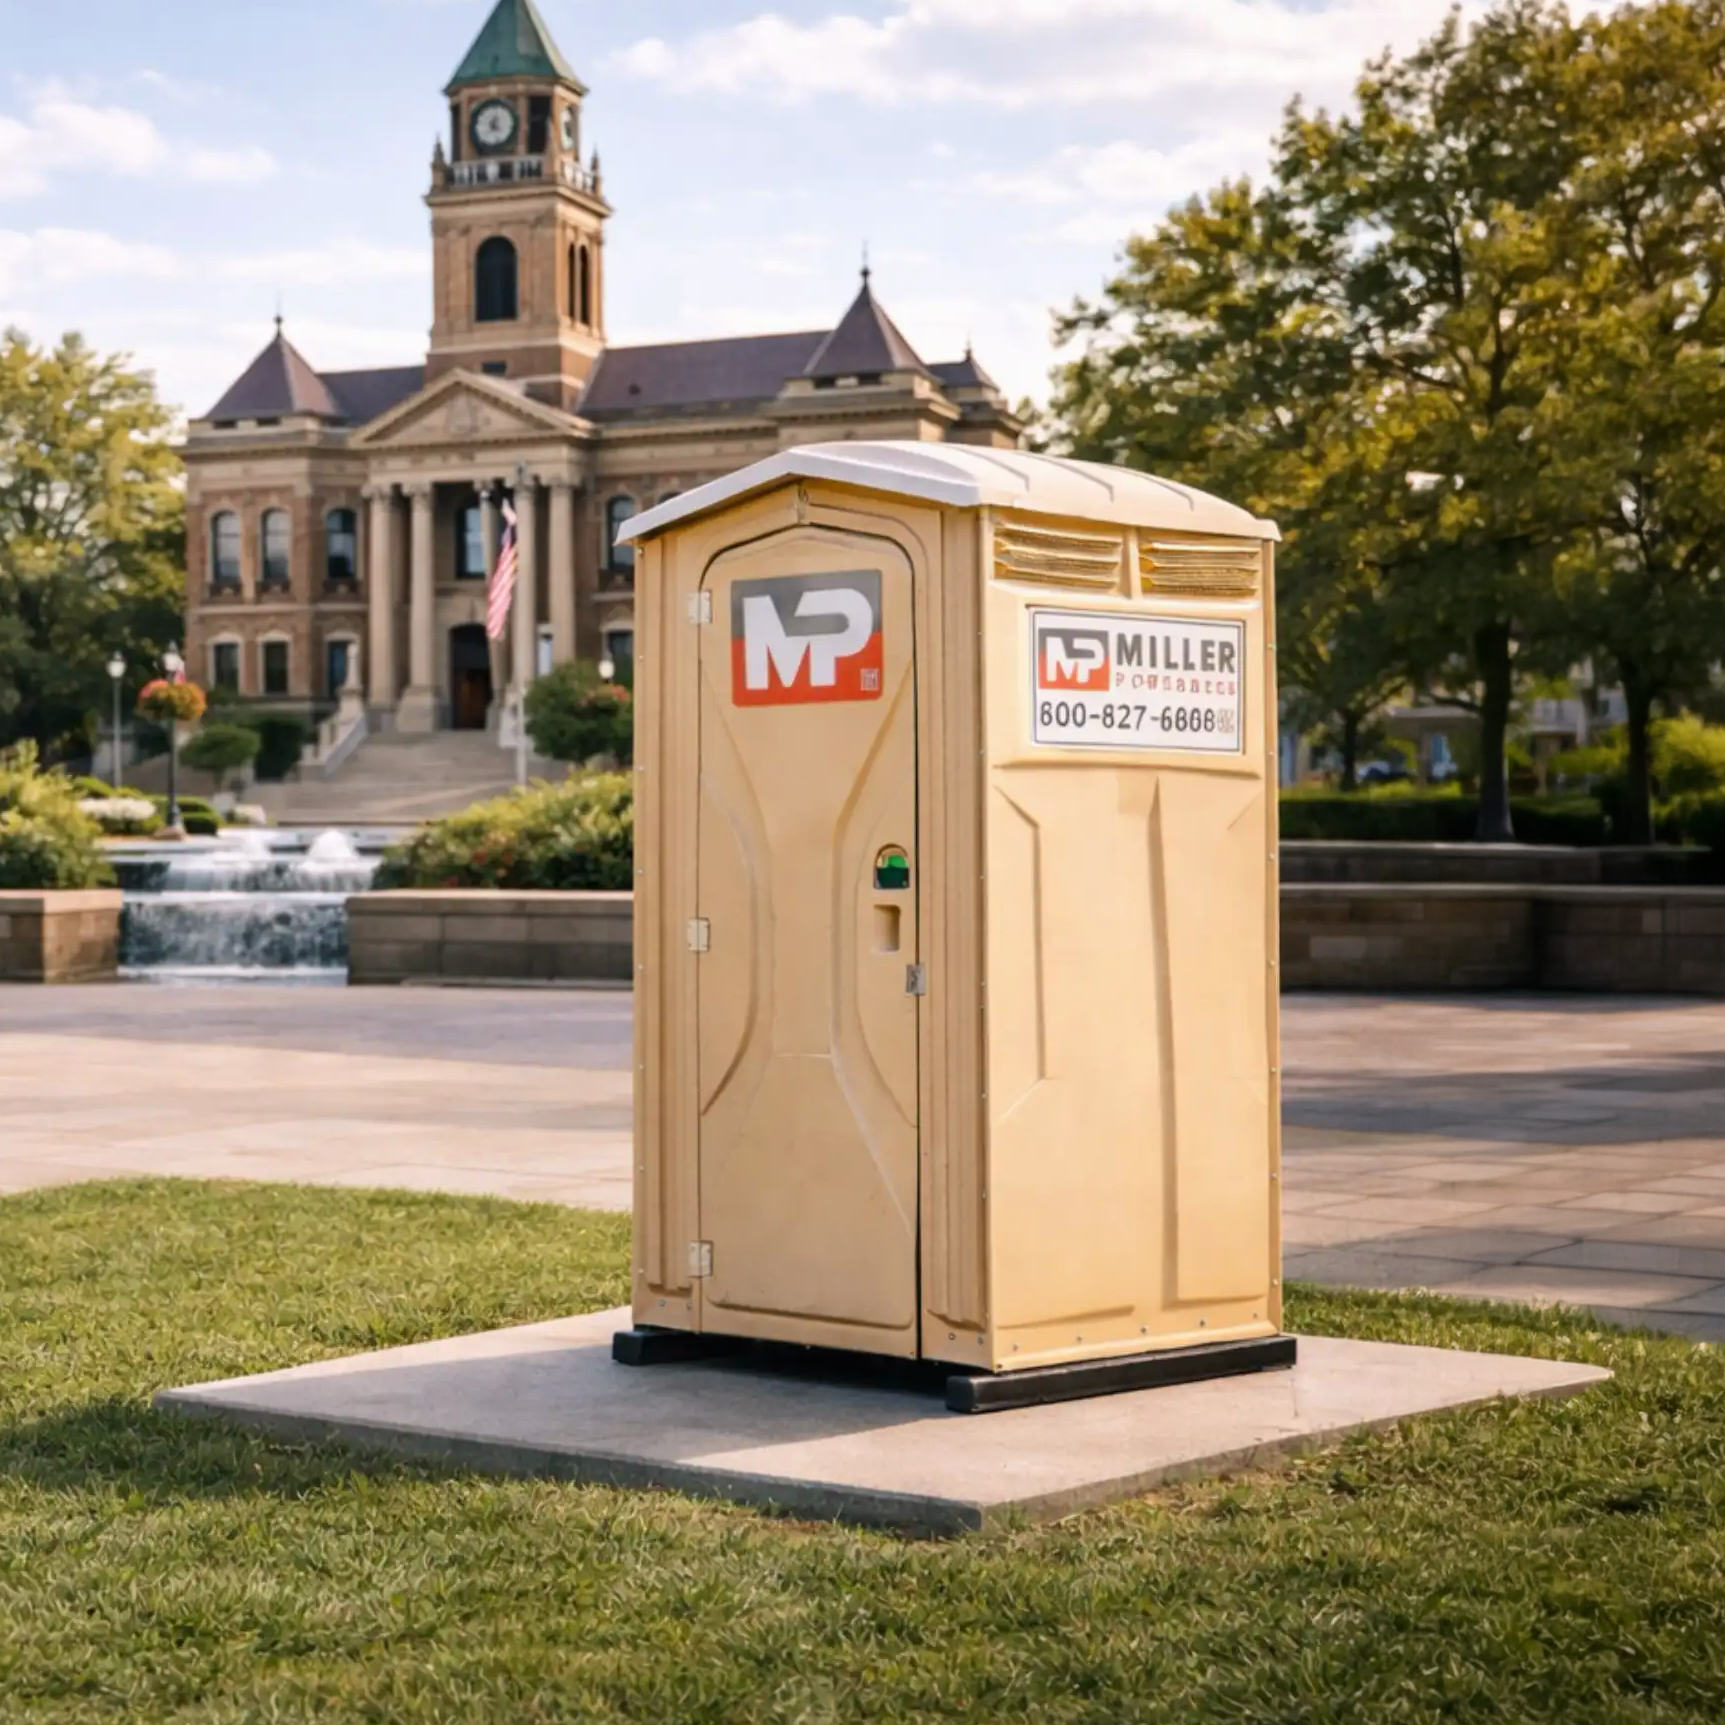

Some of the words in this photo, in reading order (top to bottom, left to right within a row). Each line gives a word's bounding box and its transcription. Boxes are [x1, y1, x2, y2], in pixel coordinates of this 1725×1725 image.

[743, 588, 873, 690] MP
[1046, 637, 1104, 684] MP
[1116, 633, 1236, 675] MILLER
